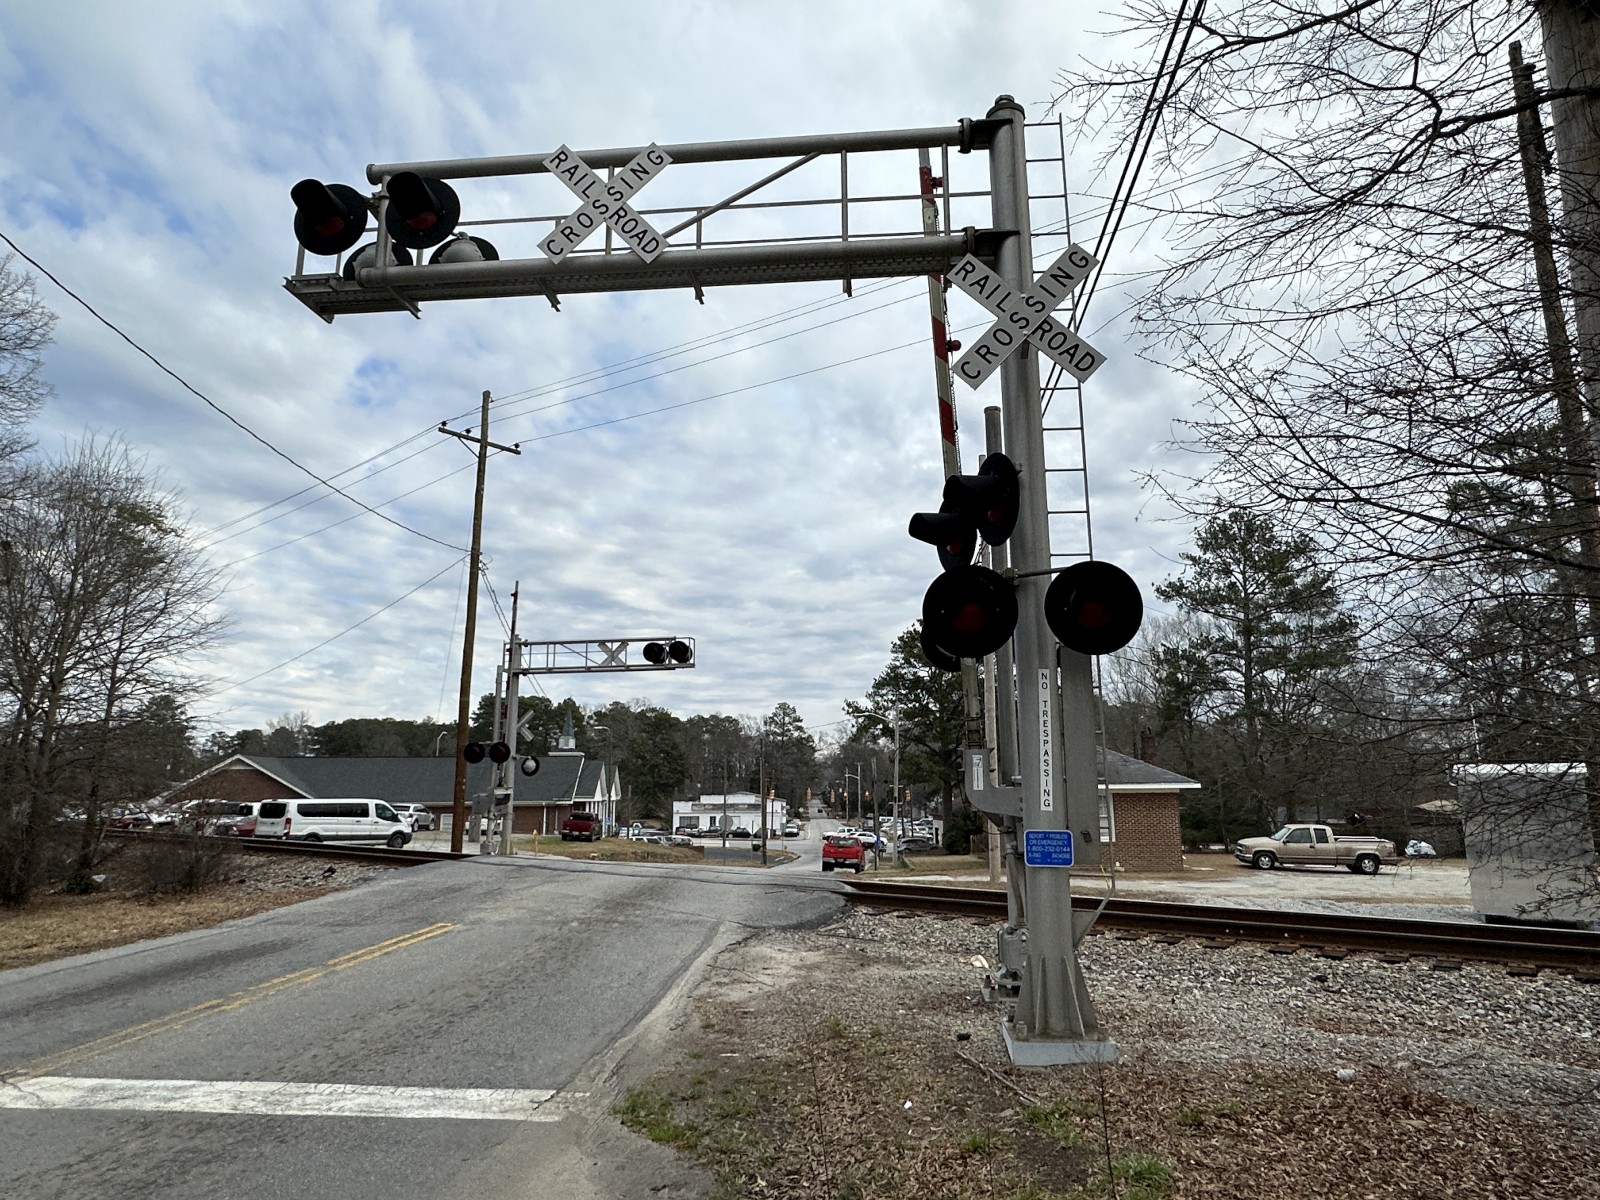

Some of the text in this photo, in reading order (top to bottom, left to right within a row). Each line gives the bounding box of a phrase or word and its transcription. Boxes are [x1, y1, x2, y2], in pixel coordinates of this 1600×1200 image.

[546, 150, 664, 256] CROSSING
[550, 150, 660, 254] RAIL ROAD
[954, 260, 1096, 373] RAIL ROAD
[960, 250, 1089, 380] CROSSING
[1041, 672, 1051, 807] NO TRESPASSING
